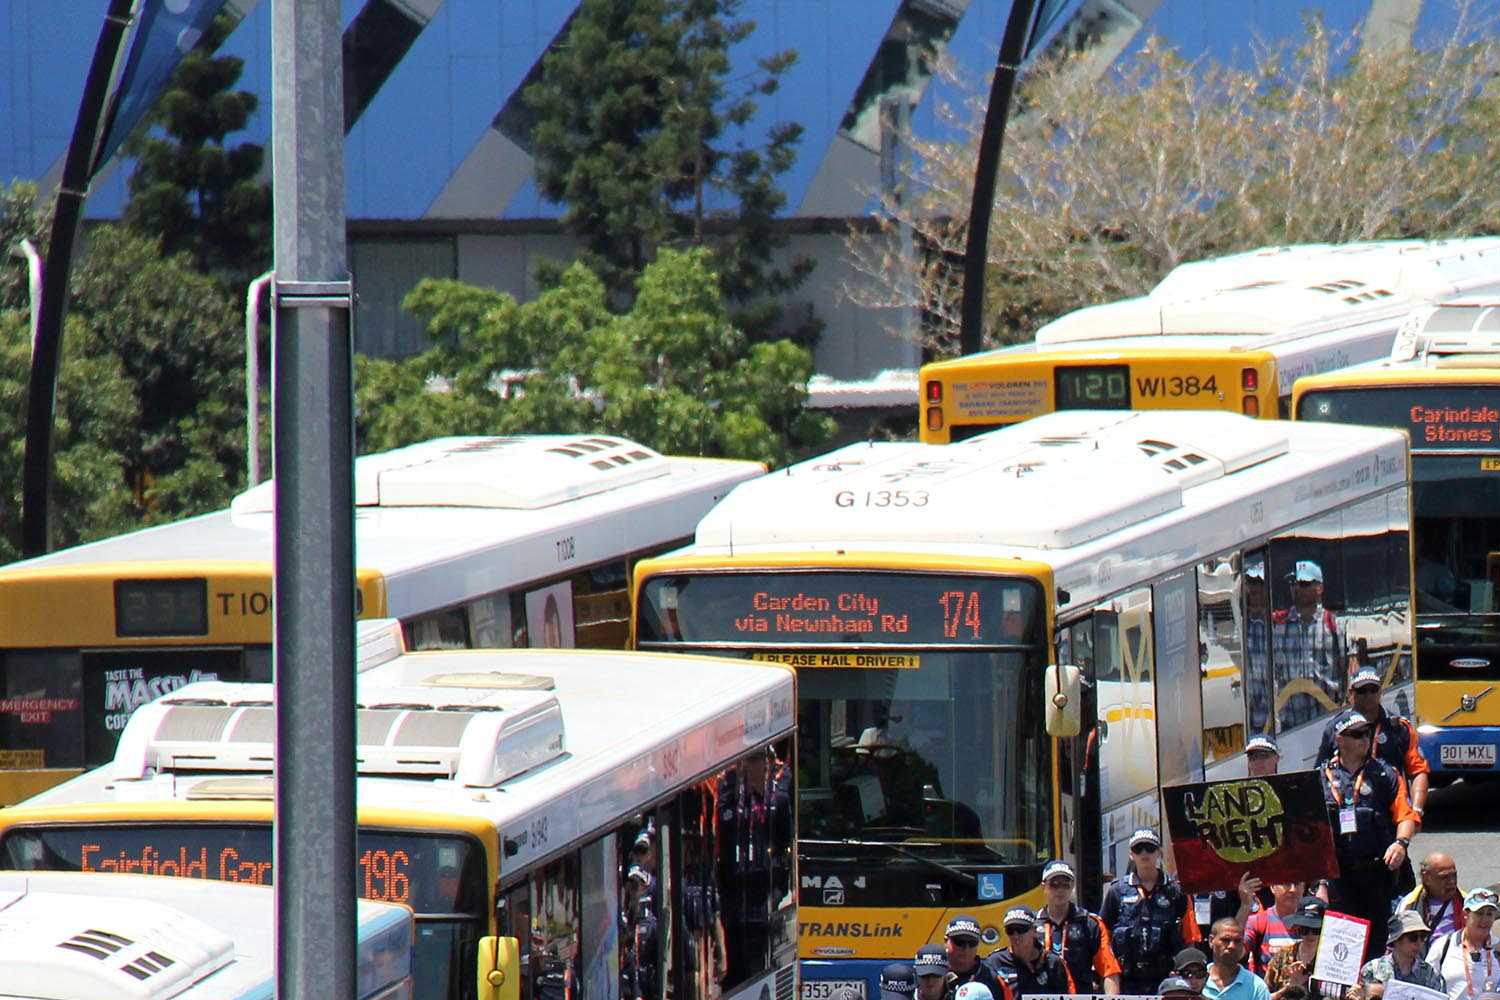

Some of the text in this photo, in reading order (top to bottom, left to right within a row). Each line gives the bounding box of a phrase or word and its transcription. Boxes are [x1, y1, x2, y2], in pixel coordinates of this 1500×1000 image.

[1136, 375, 1218, 398] W1384
[1410, 406, 1500, 423] Carindale
[1425, 425, 1493, 442] Stones
[736, 614, 910, 633] via Newnham Rd
[753, 590, 982, 640] Garden City 174
[767, 655, 903, 667] PLEASE HAIL DRIVER
[0, 699, 76, 713] MERGENCY
[20, 711, 50, 724] EXIT
[1184, 784, 1267, 820] LAND
[220, 847, 273, 886] Gar
[359, 849, 409, 902] 196
[797, 922, 903, 937] TRANSLink
